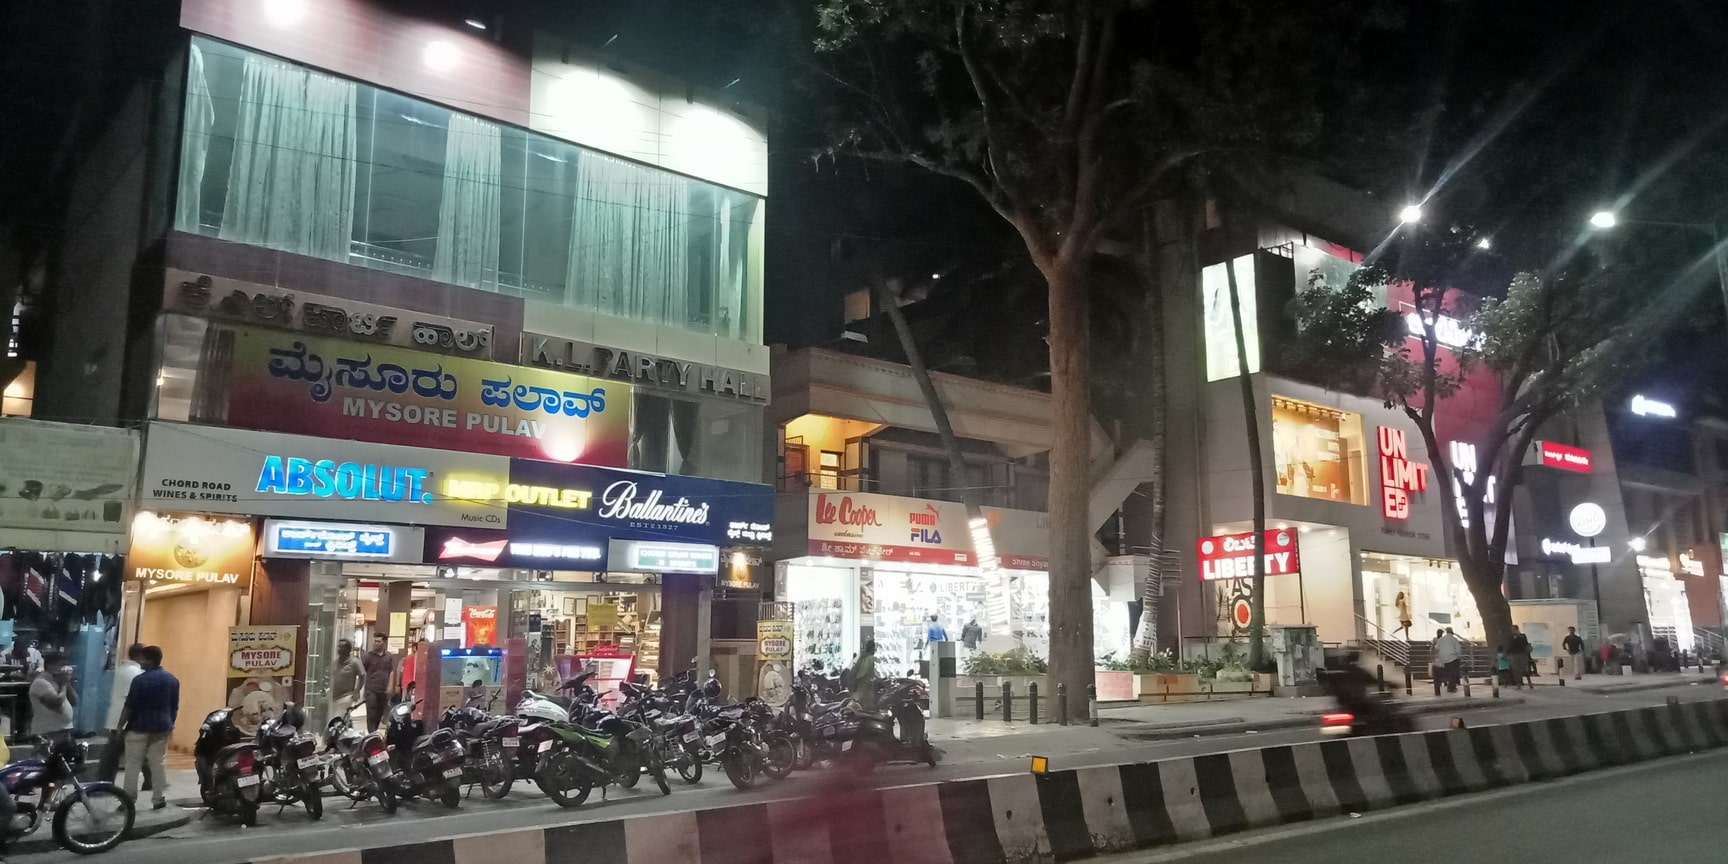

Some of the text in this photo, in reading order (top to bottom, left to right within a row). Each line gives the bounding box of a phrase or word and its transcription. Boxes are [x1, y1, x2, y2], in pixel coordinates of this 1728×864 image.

[413, 321, 491, 351] ಹಾಲ್
[268, 341, 606, 418] ಮೈಸೂರು ಪಲಾವ್
[701, 368, 768, 400] HALL
[343, 397, 547, 439] MYSORE PULAV
[1378, 426, 1407, 460] UN
[162, 479, 231, 491] CHORD ROAD
[1381, 455, 1428, 493] LIMIT
[153, 489, 238, 502] WINES & SPIRITS
[504, 484, 593, 509] OUTLET
[598, 480, 710, 525] Ballantine's
[461, 513, 501, 524] Music CDs
[815, 493, 882, 532] Lee Cooper
[909, 512, 936, 526] PUMA
[911, 528, 942, 544] FILA
[135, 568, 240, 584] MYSORE PULAV
[241, 650, 282, 660] MYSORE
